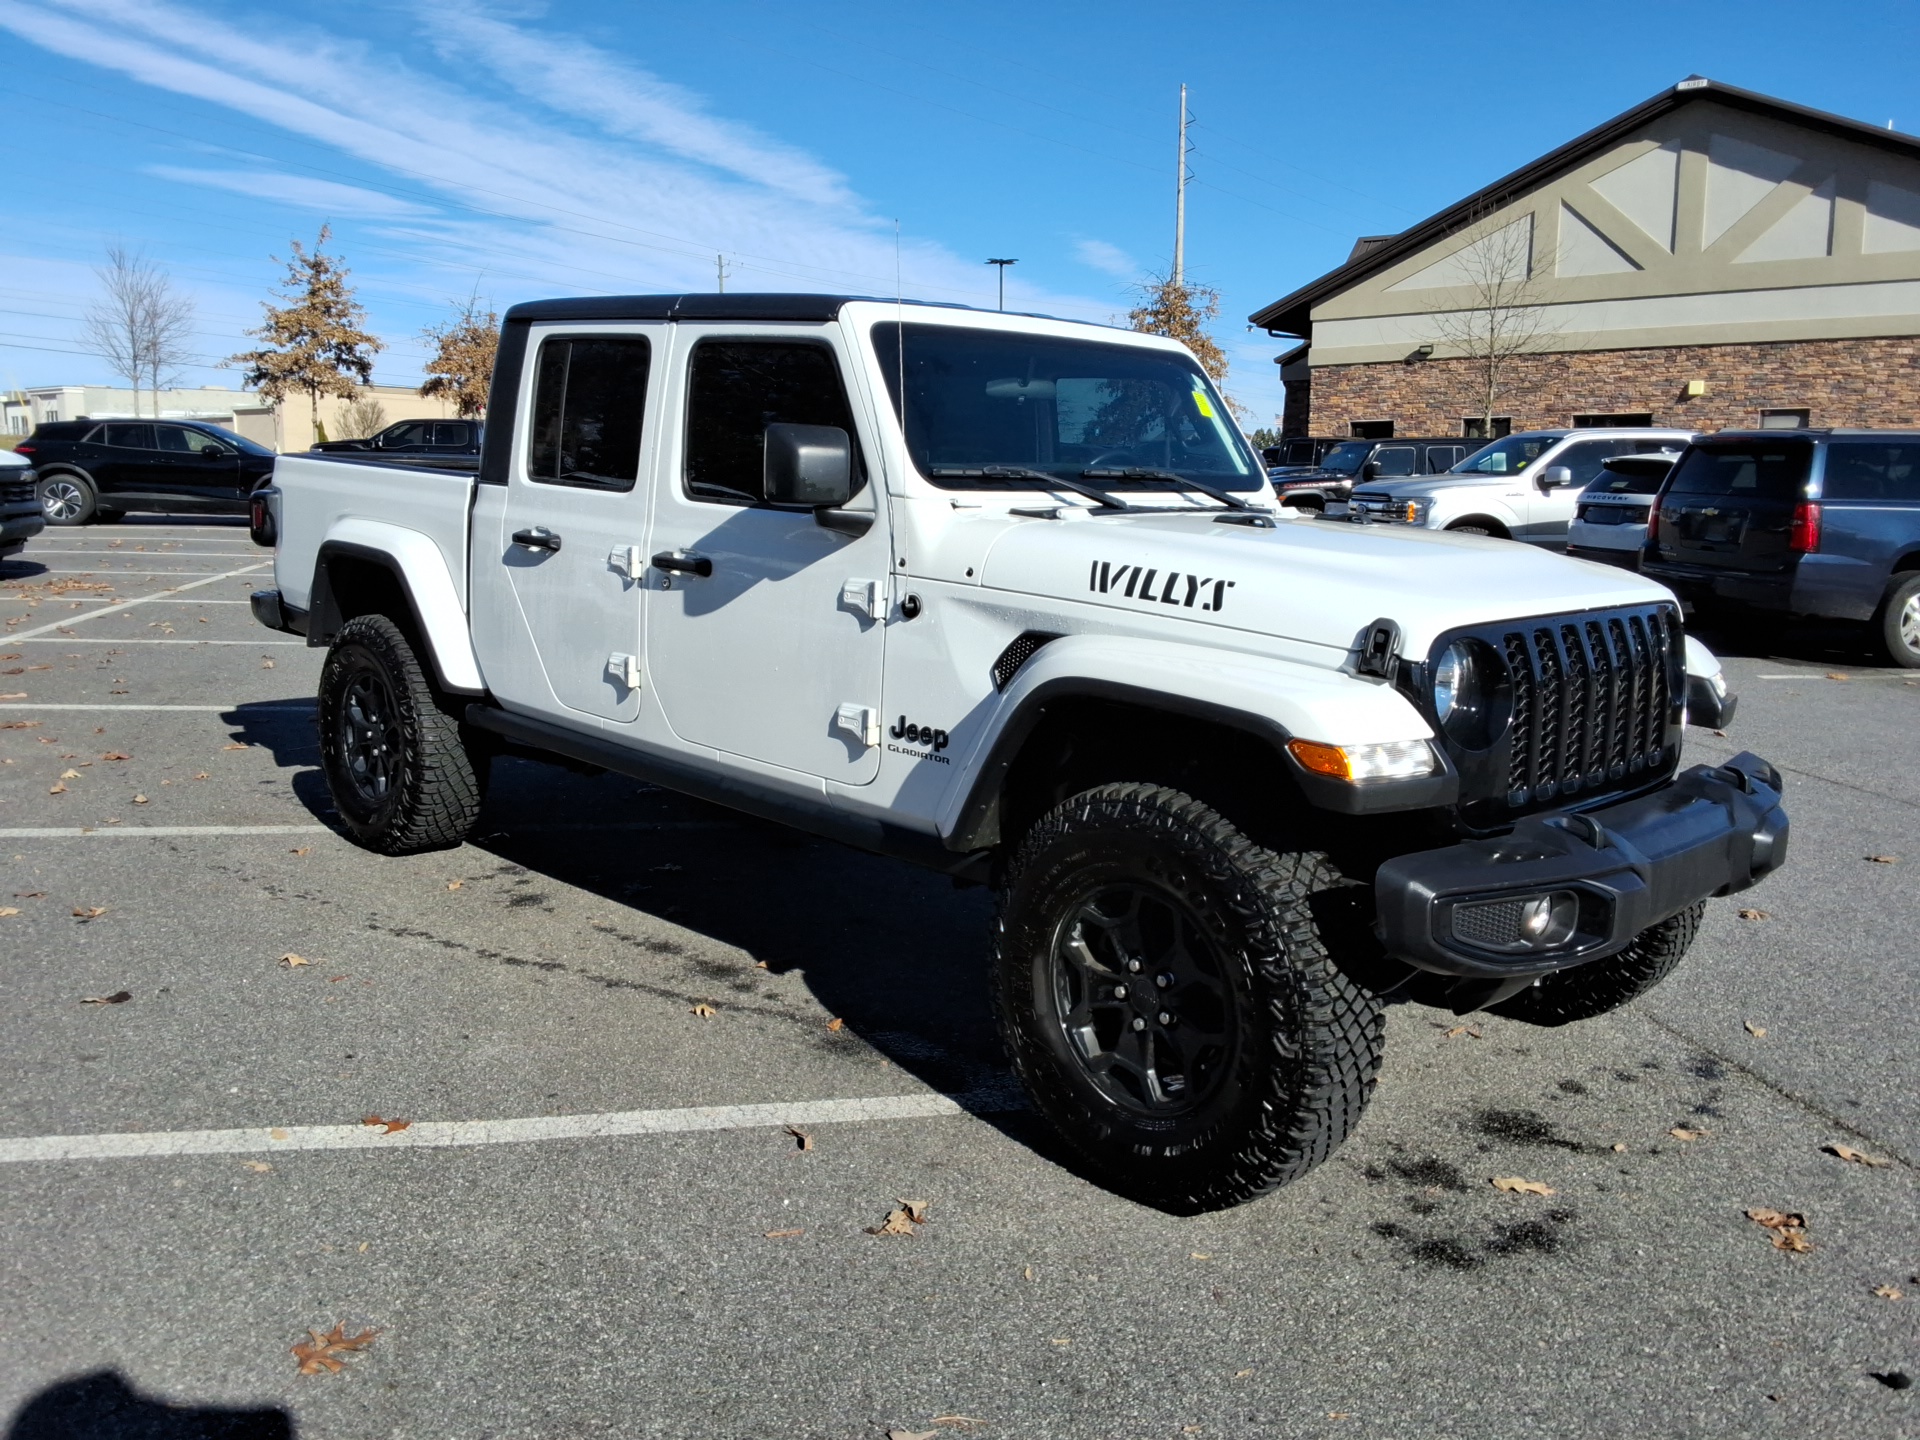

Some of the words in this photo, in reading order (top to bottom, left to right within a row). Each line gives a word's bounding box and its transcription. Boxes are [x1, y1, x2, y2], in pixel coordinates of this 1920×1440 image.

[1090, 560, 1236, 612] WILLYS
[889, 715, 949, 752] Jeep
[887, 744, 950, 765] GLADIATOR
